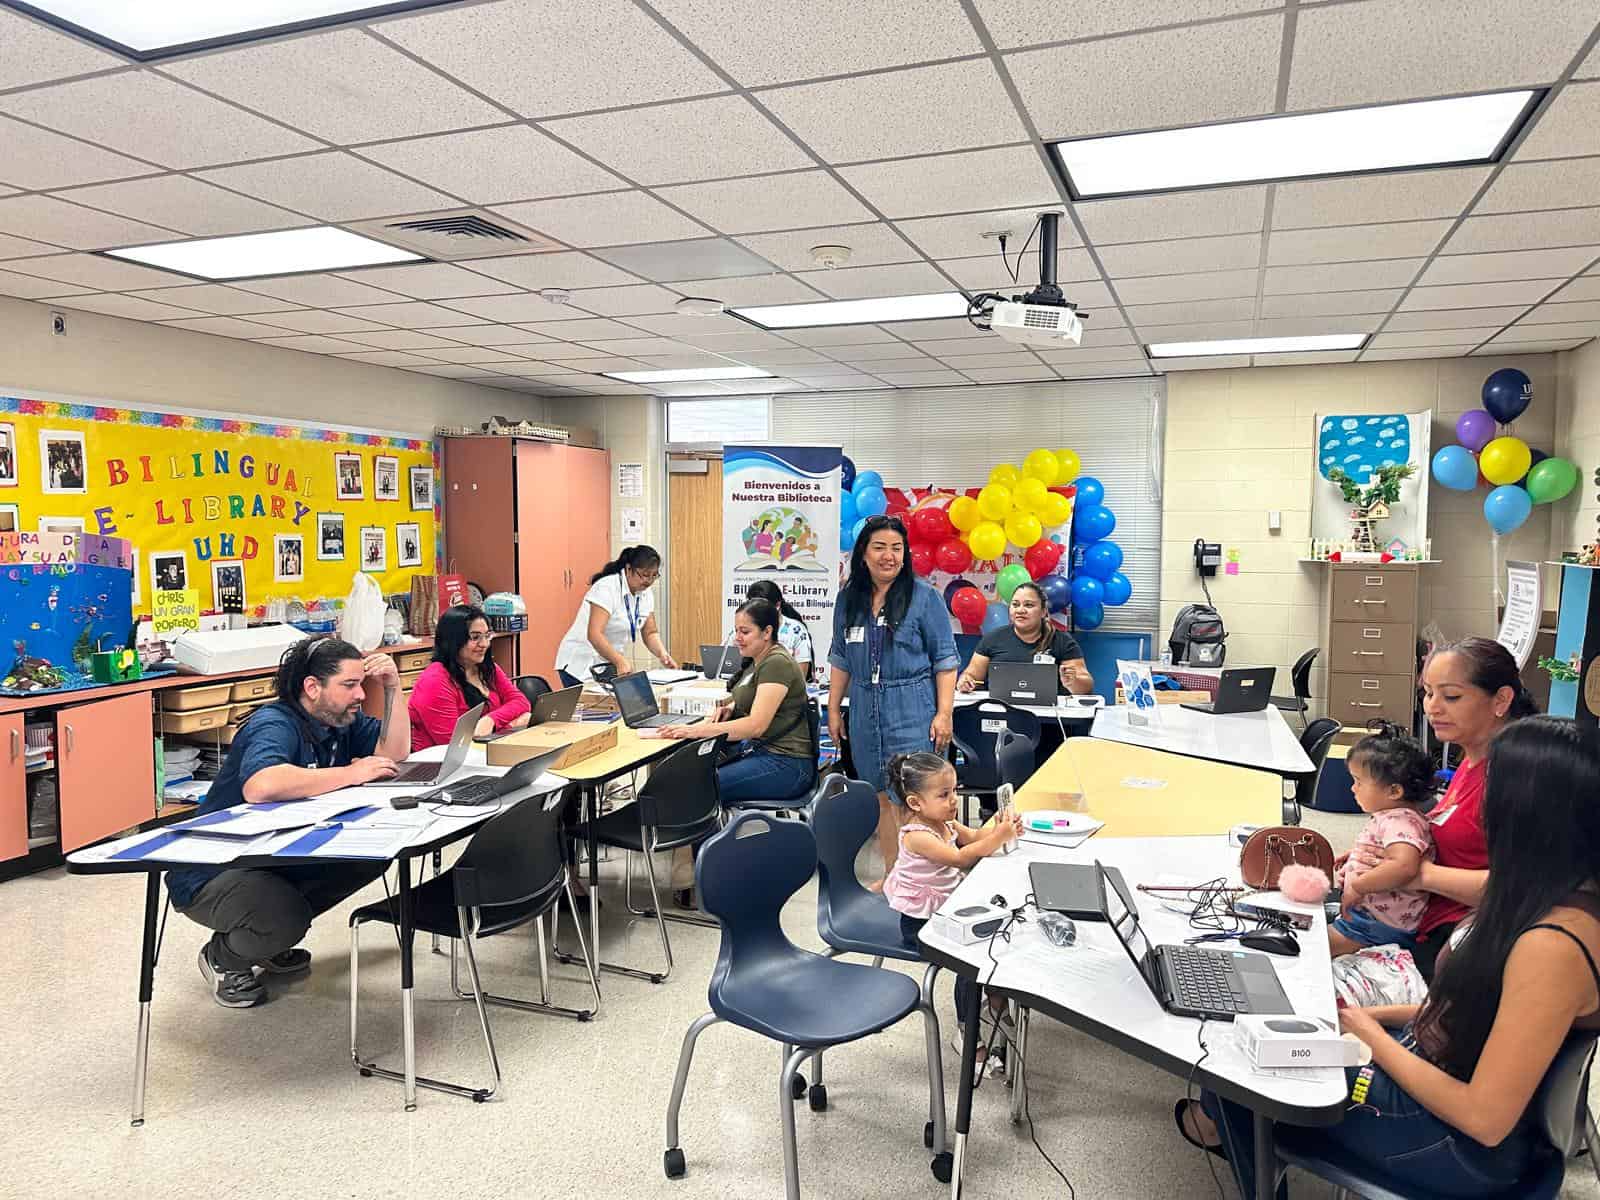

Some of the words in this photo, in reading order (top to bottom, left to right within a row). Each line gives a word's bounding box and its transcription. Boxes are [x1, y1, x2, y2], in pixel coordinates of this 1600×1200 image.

[744, 481, 811, 491] Bienvenidos
[814, 483, 821, 491] a
[732, 493, 775, 503] Nuestra
[778, 493, 832, 504] Biblioteca
[155, 494, 311, 526] LIBRARY
[194, 532, 259, 561] UHD
[783, 585, 828, 596] E-Library
[157, 592, 184, 605] CHRIS
[154, 607, 168, 617] UN
[170, 604, 195, 616] GRAN
[1291, 1048, 1311, 1057] B100
